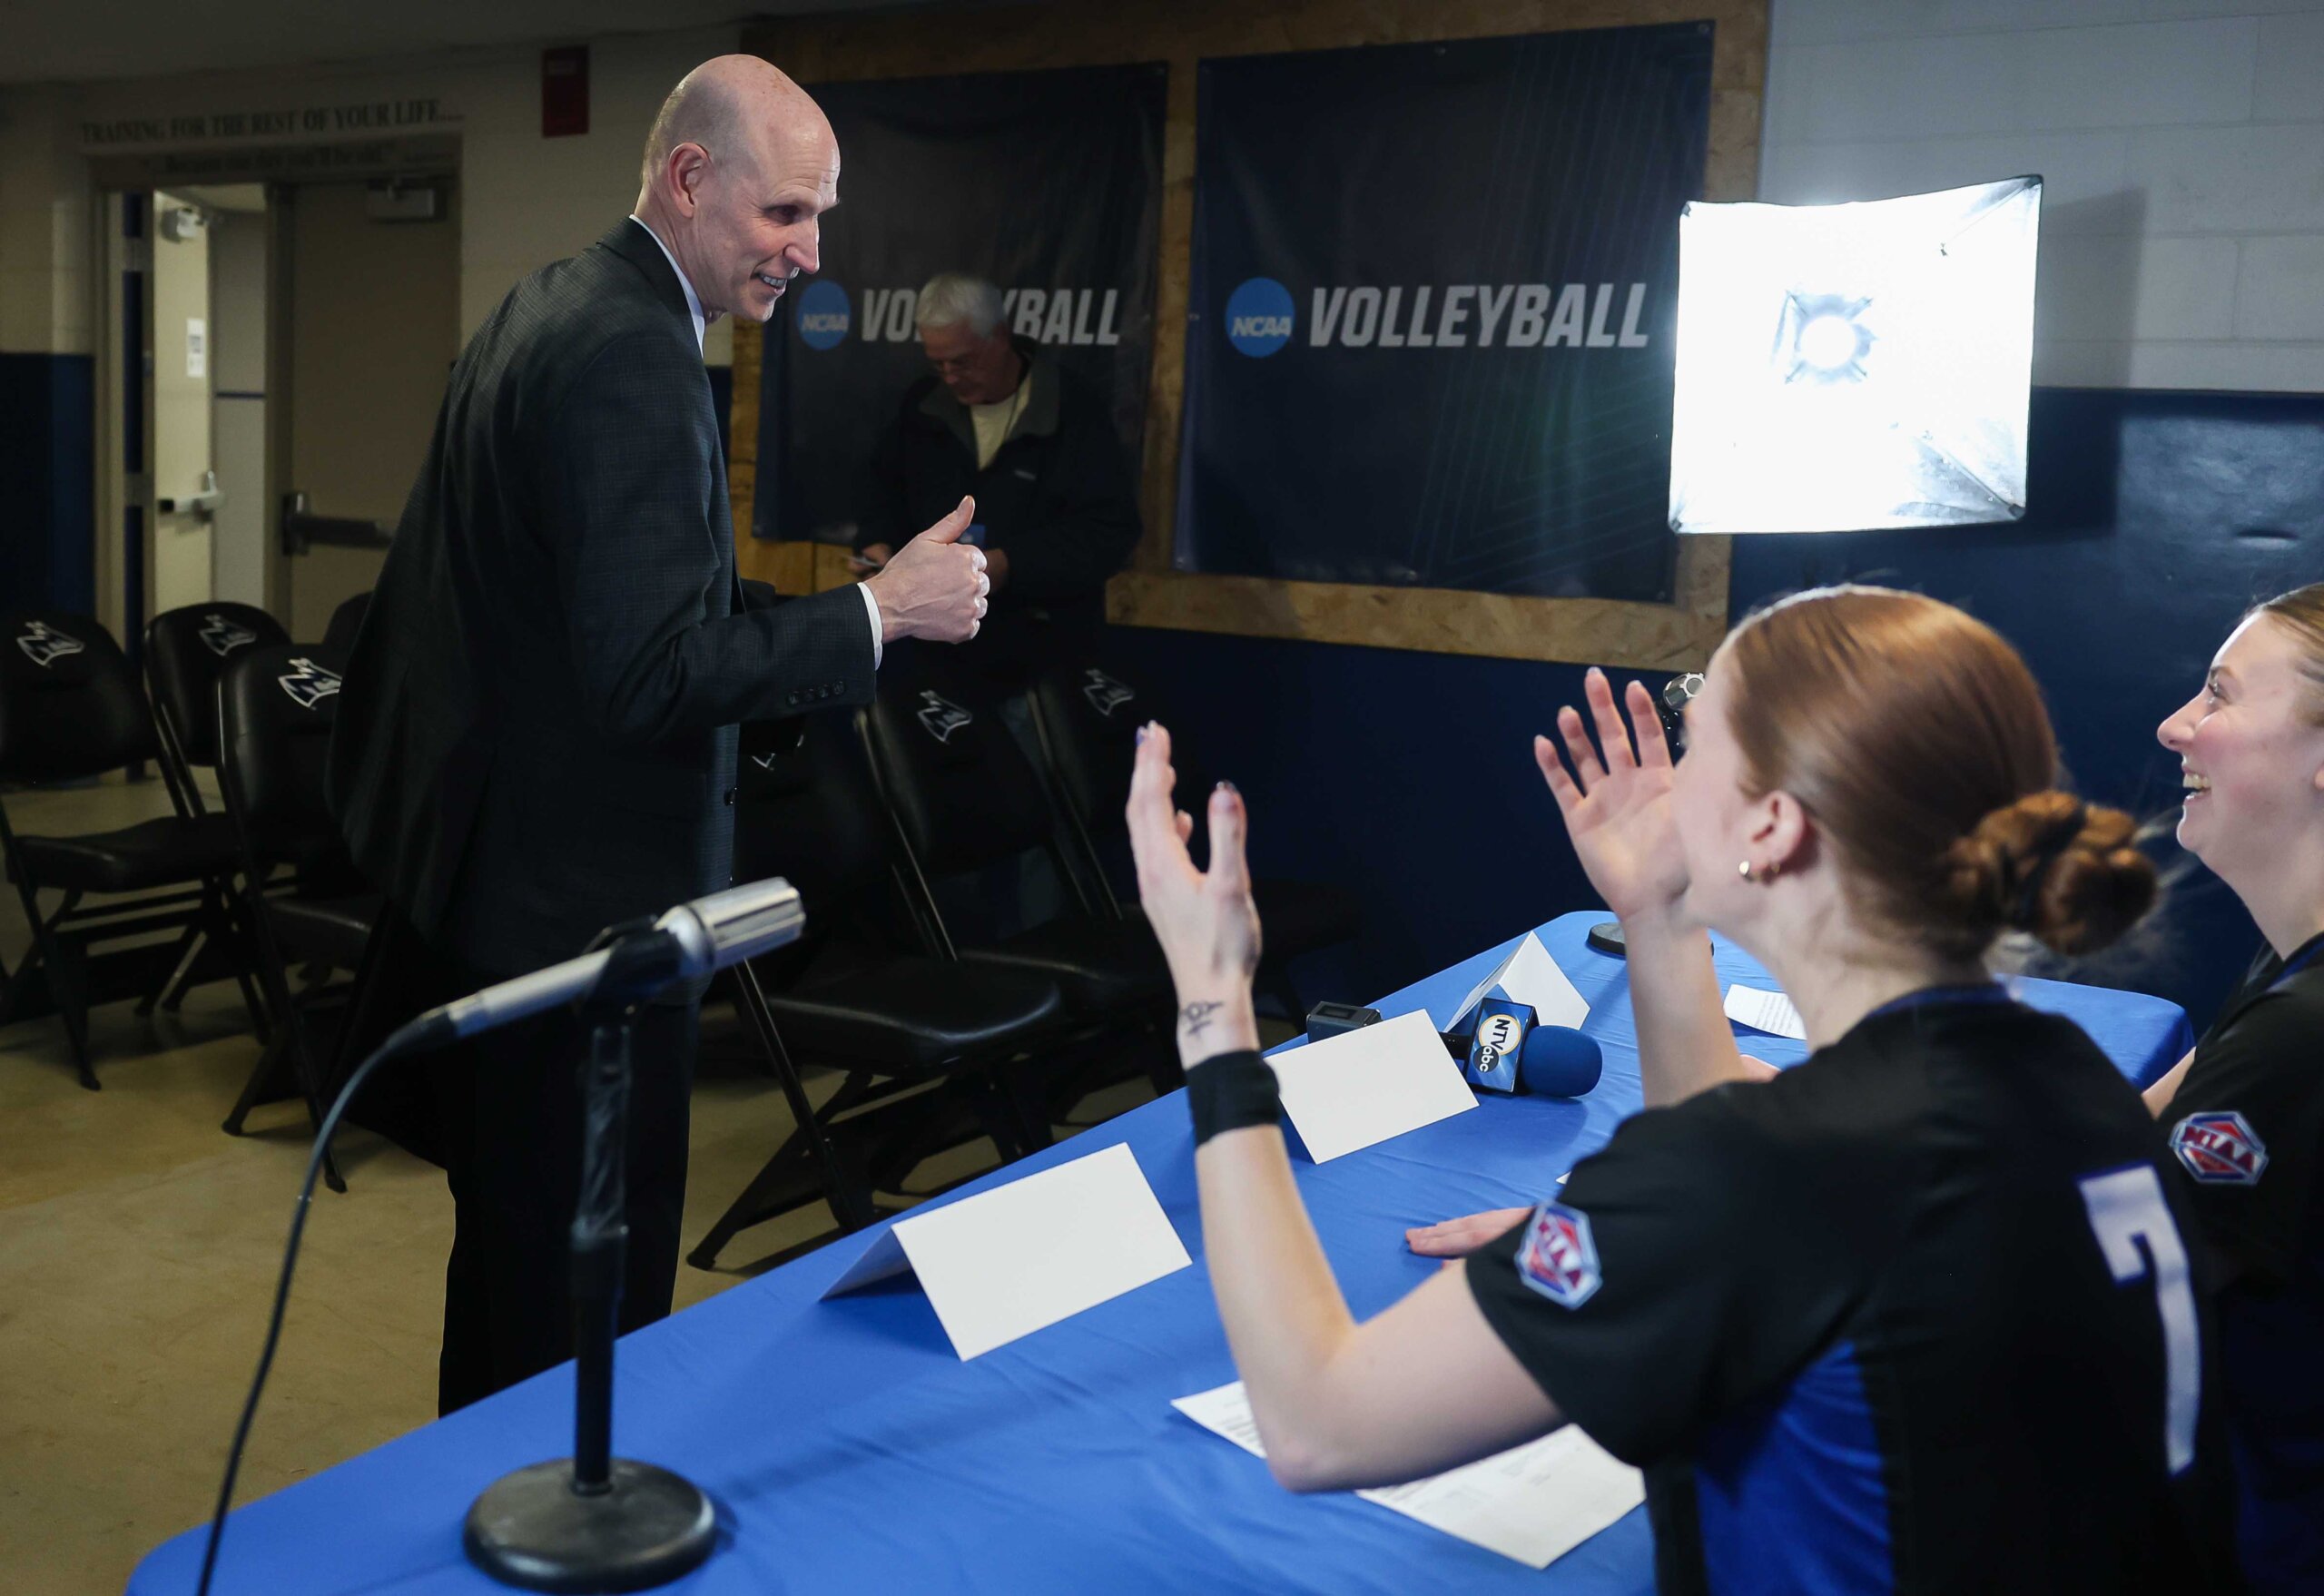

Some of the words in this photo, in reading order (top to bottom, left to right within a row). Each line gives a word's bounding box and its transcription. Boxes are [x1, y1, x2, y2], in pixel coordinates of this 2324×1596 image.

[171, 117, 207, 138] FOR
[212, 113, 245, 136] THE
[251, 110, 296, 134] REST
[303, 107, 330, 131] OF
[334, 103, 389, 129] YOUR
[802, 312, 849, 334] NCAA
[861, 288, 1120, 346] VOBALL
[1230, 316, 1293, 338] NCAA
[1308, 282, 1649, 349] VOLLEYBALL
[1491, 1019, 1512, 1050] NTV
[1479, 1046, 1494, 1073] abc
[2076, 1161, 2202, 1477] 7
